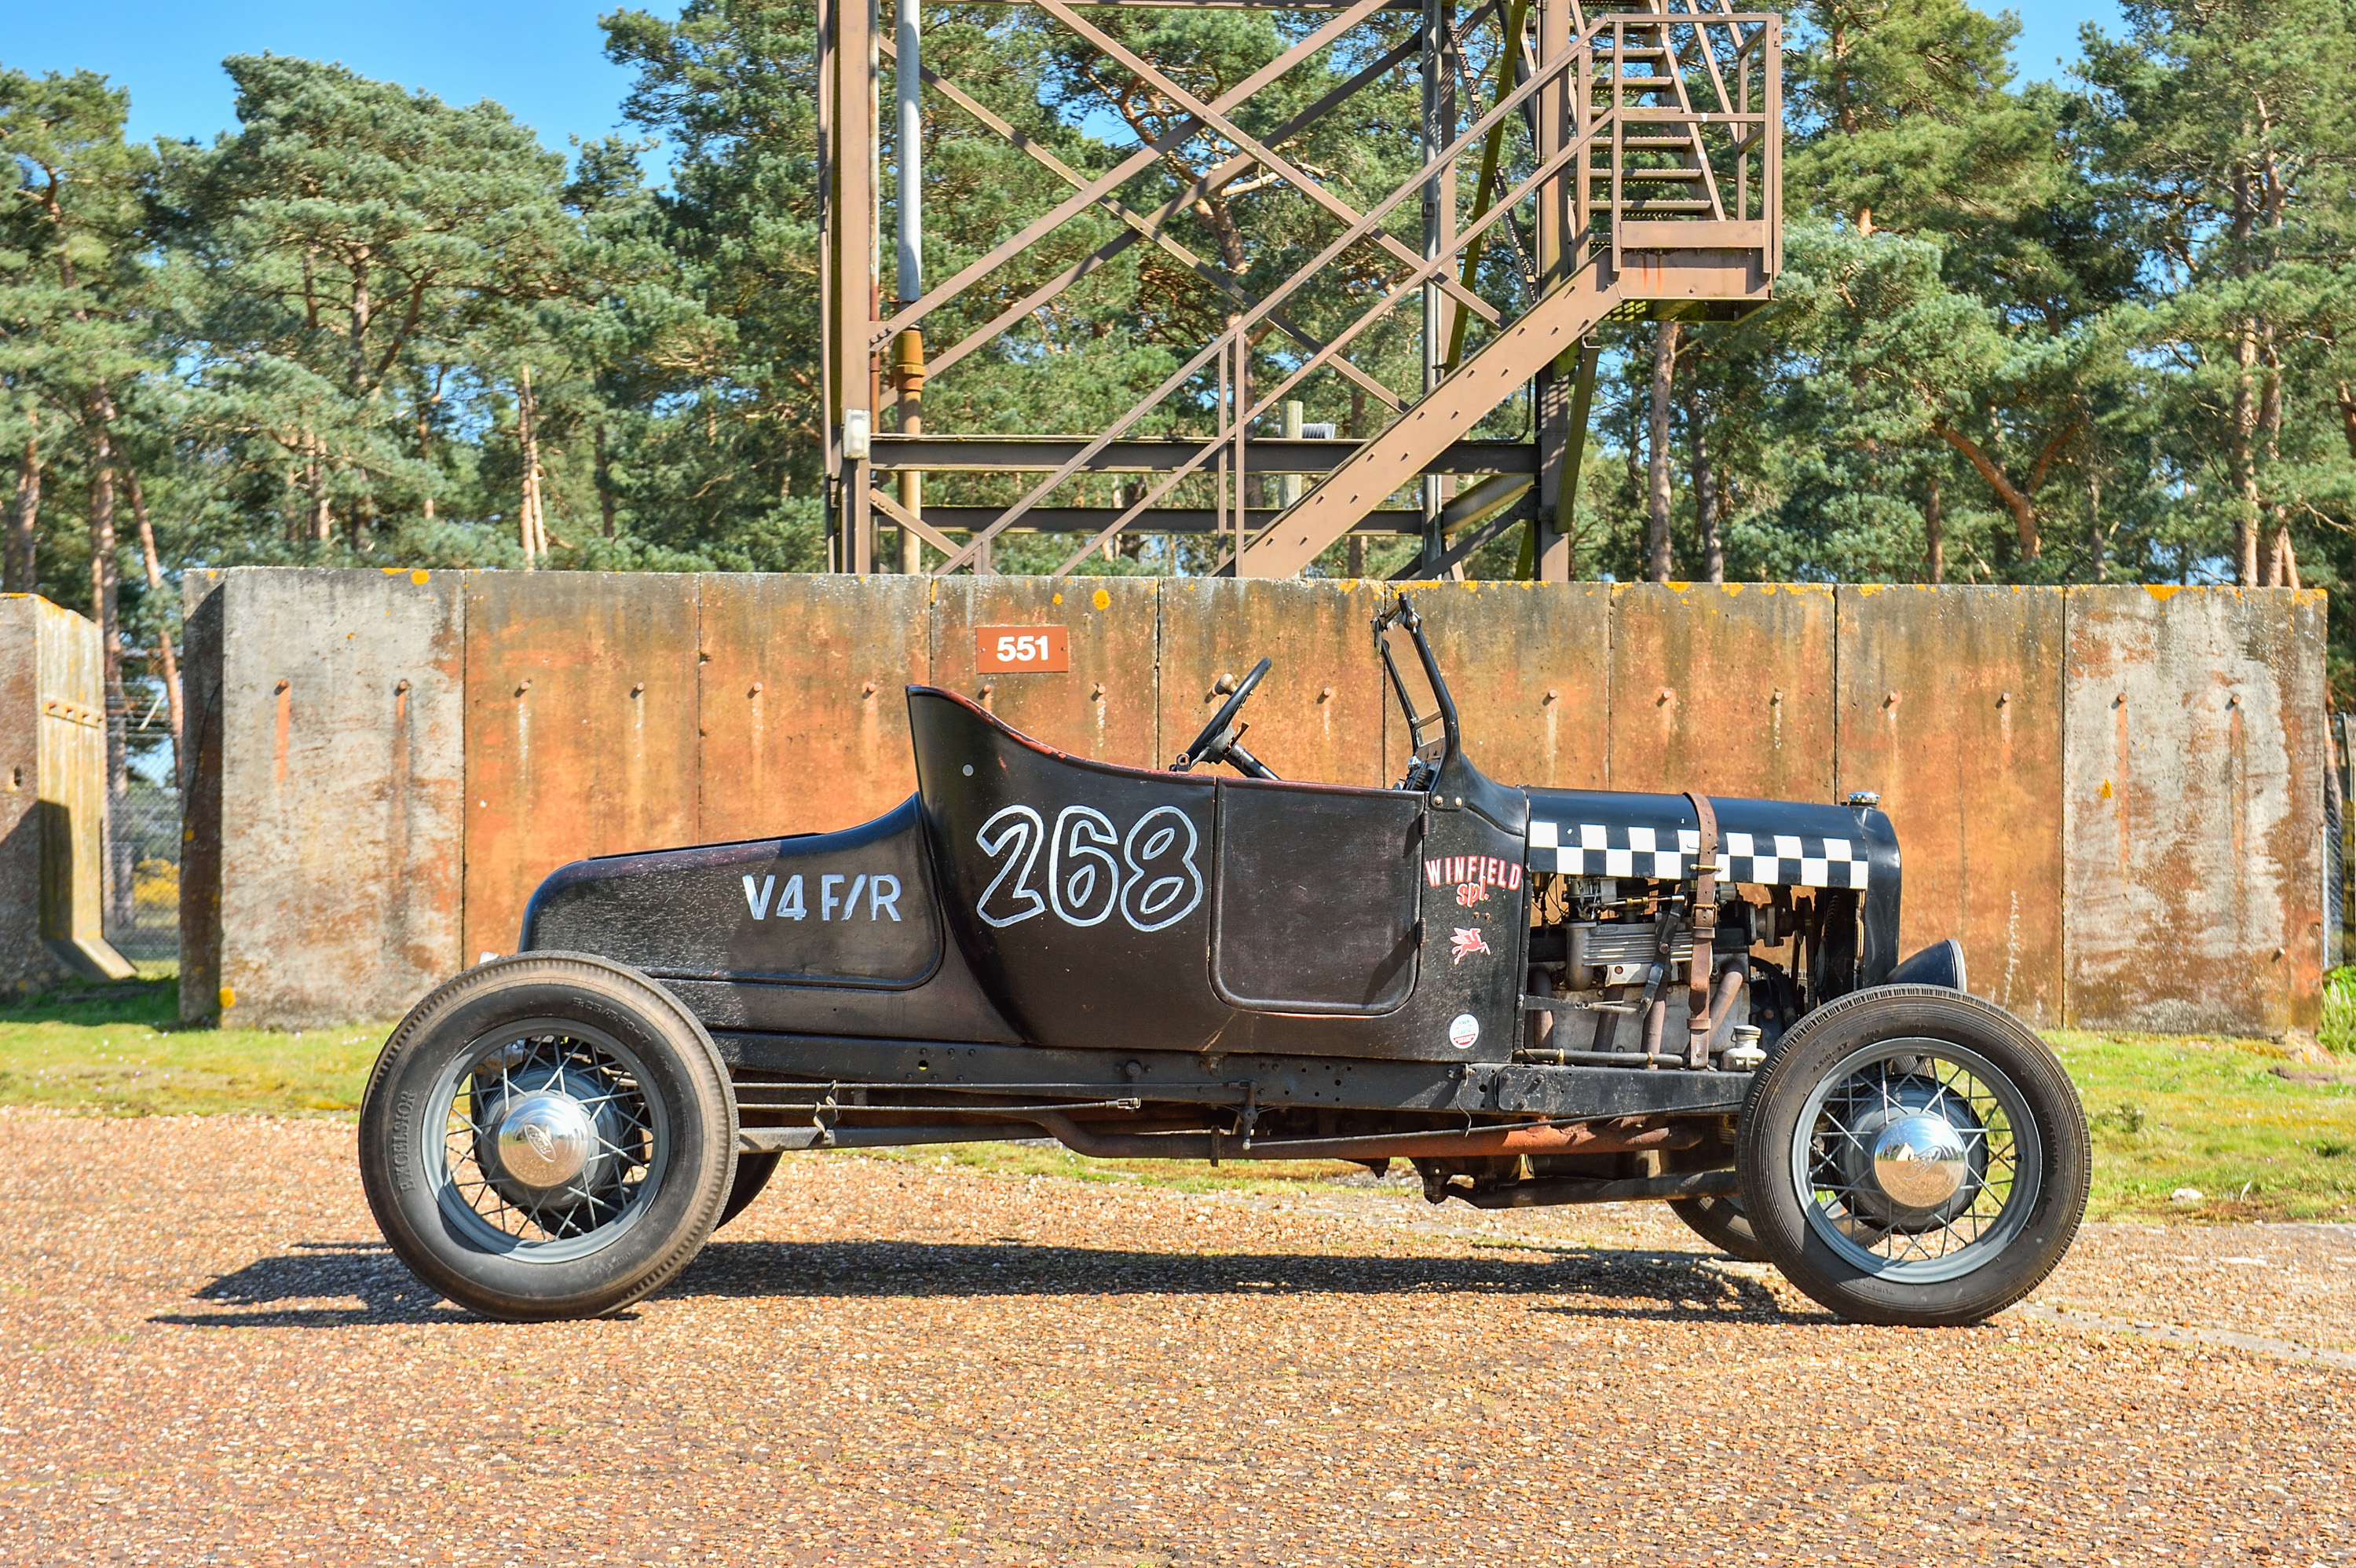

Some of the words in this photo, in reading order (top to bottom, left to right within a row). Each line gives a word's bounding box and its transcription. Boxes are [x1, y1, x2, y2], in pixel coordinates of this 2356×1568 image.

[996, 635, 1048, 662] 551
[976, 804, 1204, 933] 268
[1425, 855, 1523, 891] WINFIELD
[742, 873, 807, 921] V4
[821, 873, 902, 922] F/R
[393, 1089, 416, 1194] EXCELSIOR
